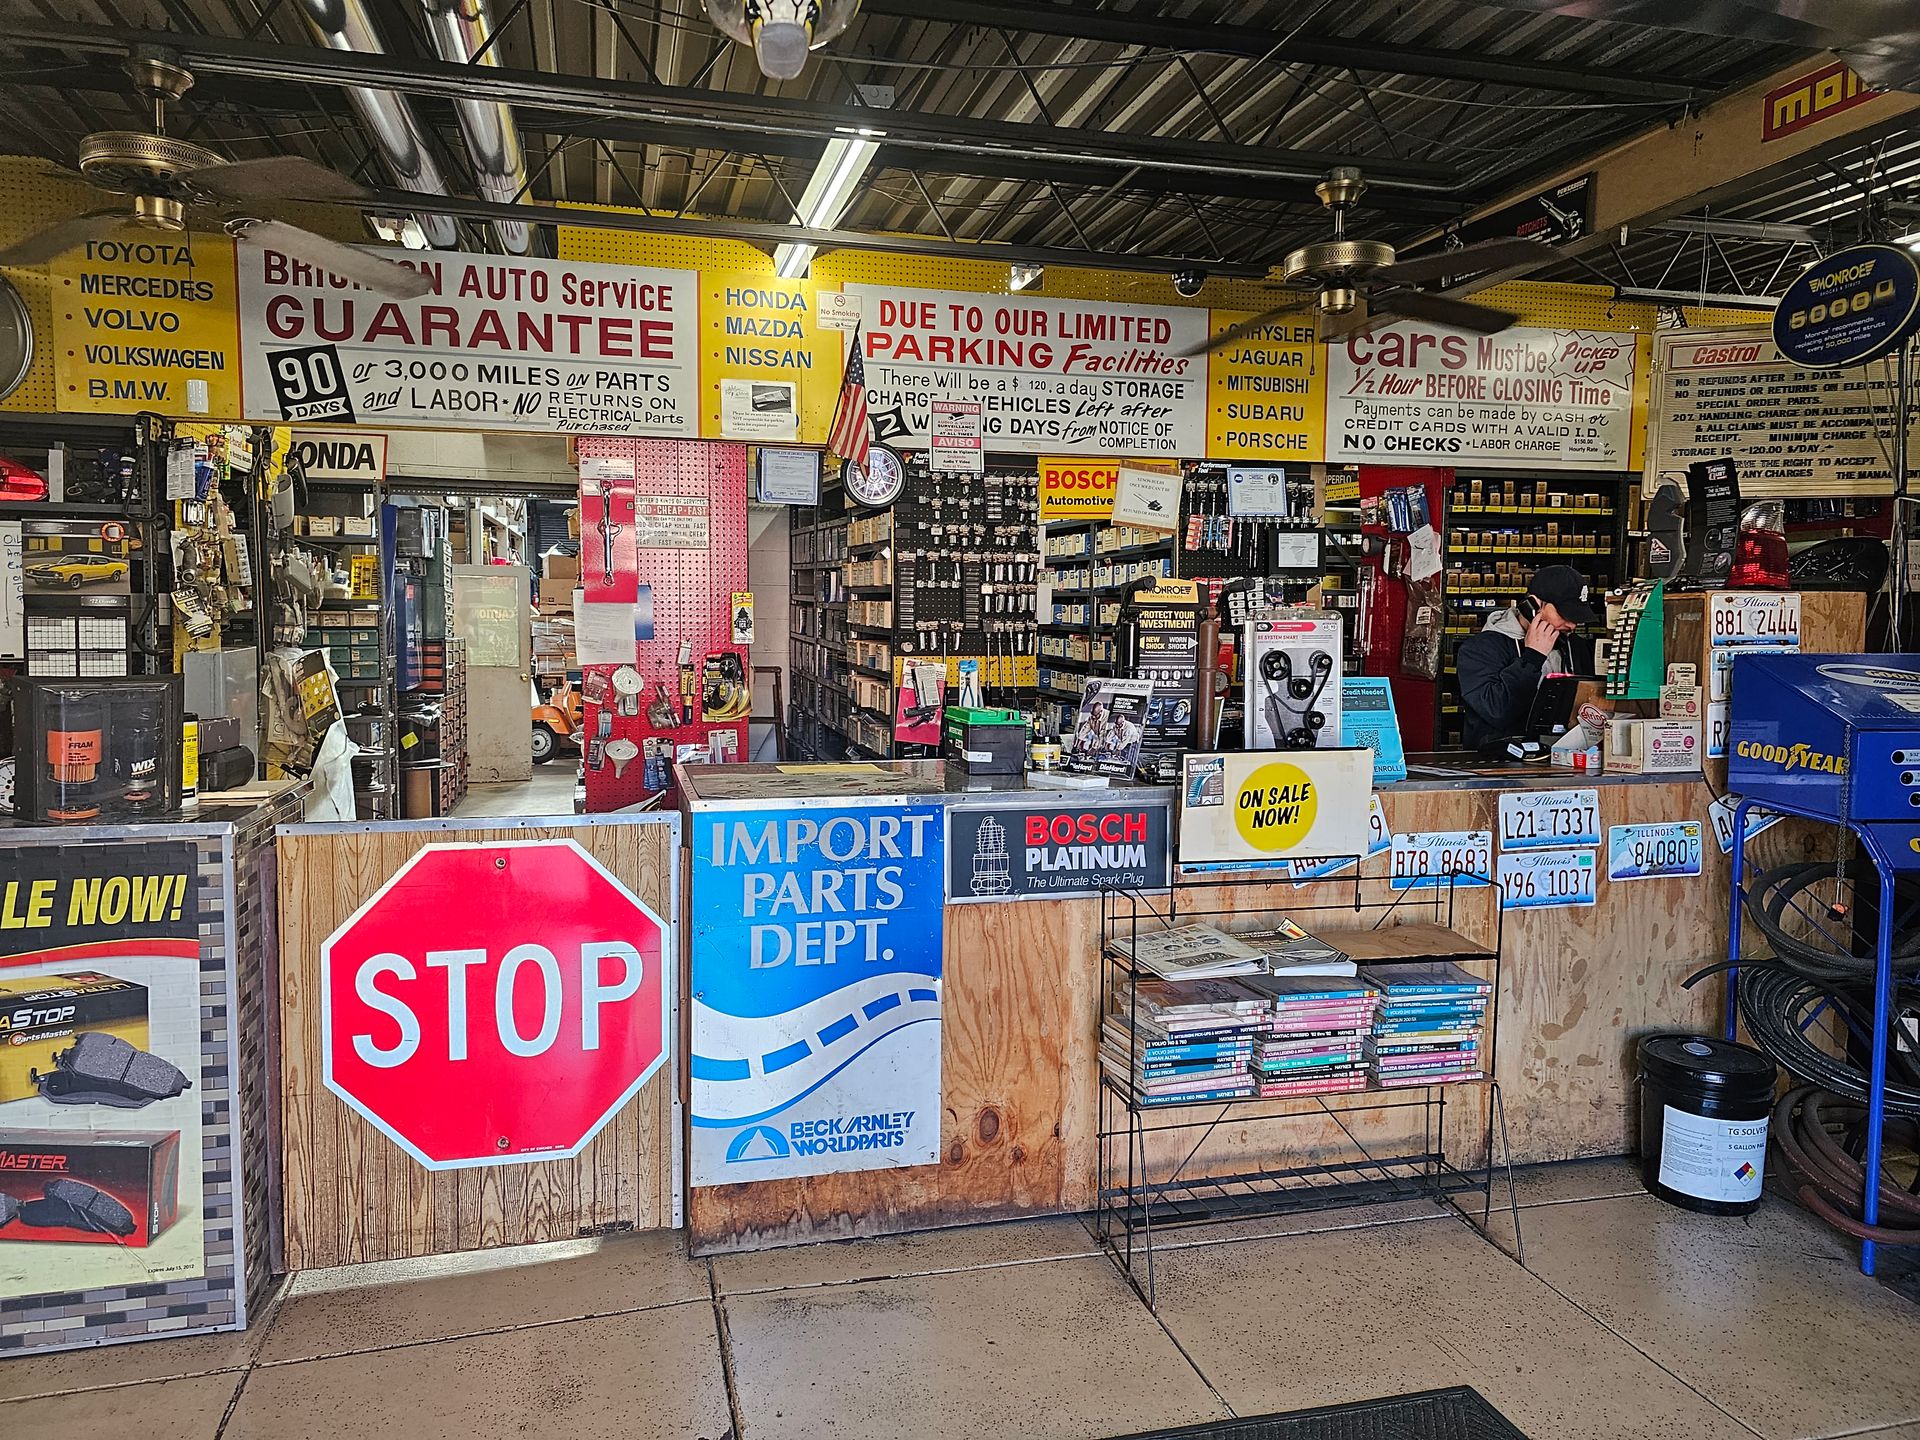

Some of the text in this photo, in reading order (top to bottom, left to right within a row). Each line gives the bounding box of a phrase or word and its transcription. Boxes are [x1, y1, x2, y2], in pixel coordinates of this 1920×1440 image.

[1516, 216, 1548, 237] RATCHETS
[87, 241, 195, 267] TOYOTA
[1809, 259, 1876, 293] MONROE
[81, 274, 214, 301] MERCEDES
[459, 262, 672, 312] AUTO Service
[726, 288, 807, 311] HONDA
[84, 308, 180, 332] VOLVO
[832, 310, 860, 320] Smoking
[880, 300, 1171, 344] DUE TO OUR LIMITED
[1832, 317, 1874, 332] recommends
[265, 295, 674, 359] GUARANTEE
[726, 317, 803, 338] MAZDA
[1824, 321, 1886, 341] shocks struts
[1853, 333, 1871, 342] miles
[85, 345, 224, 370] VOLKSWAGEN
[726, 347, 812, 368] NISSAN
[866, 332, 1189, 375] PARKING Facilities
[1229, 349, 1304, 367] JAGUAR
[1477, 337, 1521, 372] Must
[1525, 347, 1547, 373] be
[1560, 341, 1619, 362] PICKED
[1692, 344, 1762, 365] Castrol
[277, 351, 338, 400] 90
[353, 360, 670, 393] or 3,000 MILES ON PARTS
[1574, 362, 1606, 375] UP
[1698, 370, 1845, 386] REFUNDS AFTER DAYS.
[89, 379, 171, 401] B.M.W.
[880, 368, 1184, 400] There Will be day STORAGE
[1227, 375, 1309, 394] MITSUBISHI
[1378, 373, 1422, 396] Hour
[1425, 373, 1486, 400] BEFORE
[1492, 377, 1563, 404] CLOSING
[1568, 381, 1611, 406] Time
[1698, 384, 1817, 398] REFUNDS RETURNS
[296, 400, 340, 419] DAYS
[362, 387, 676, 415] and LABOR NO RETURNS ON
[933, 403, 979, 413] WARNING
[981, 395, 1173, 418] VEHICLES Left after
[1696, 396, 1823, 410] SPECIAL ORDER PARTS.
[547, 405, 684, 425] ELECTRICAL Parts
[1227, 405, 1304, 421] SUBARU
[1355, 400, 1609, 426] Payments can be made by CASH or
[1699, 408, 1801, 421] HANDLING CHARGE
[556, 419, 630, 433] Purchased
[1010, 411, 1059, 436] DAYS
[1062, 425, 1097, 445] from
[1099, 421, 1153, 436] NOTICE
[1155, 422, 1174, 437] OF
[1344, 419, 1601, 438] CREDIT CARDS WITH VALID I.D.
[1728, 421, 1765, 431] CLAIMS
[938, 438, 975, 447] AVISO
[1099, 437, 1177, 450] COMPLETION
[1226, 432, 1308, 449] PORSCHE
[1344, 435, 1560, 452] NO CHECKS LABOR CHARGE
[1695, 431, 1819, 443] RECEIPT. MINIMUM
[288, 441, 376, 470] ONDA
[1568, 446, 1586, 454] Hourly
[1200, 462, 1232, 470] Performance
[1780, 456, 1877, 467] RIGHT ACCEPT
[1045, 470, 1118, 490] BOSCH
[1764, 468, 1814, 478] CHARGES
[657, 505, 707, 516] CHEAP FAST
[1045, 495, 1114, 507] Automotive
[1139, 610, 1195, 619] PROTECT YOUR
[1716, 609, 1797, 635] 881 2444
[1342, 688, 1384, 696] Credit Needed
[68, 741, 93, 750] FRAM
[131, 757, 157, 772] WIX
[1737, 740, 1847, 775] GOODYEAR
[1099, 764, 1126, 773] DieHard
[1188, 763, 1221, 774] UNICOIL
[1240, 783, 1310, 809] ON SALE
[1252, 807, 1299, 829] NOW!
[1504, 807, 1594, 840] L21 7337
[1025, 812, 1148, 847] BOSCH
[1636, 828, 1675, 838] ILLINOIS
[711, 814, 934, 867] IMPORT
[1025, 845, 1147, 872] PLATINUM
[1441, 849, 1488, 876] 8683
[1634, 840, 1687, 867] 84080
[1026, 873, 1145, 889] The Ultimate Spark Plug
[1503, 869, 1591, 900] Y96 1037
[66, 874, 188, 928] NOW!
[743, 866, 904, 918] PARTS
[750, 918, 895, 969] DEPT.
[351, 941, 645, 1069] STOP
[1727, 1127, 1739, 1136] TG
[790, 1131, 905, 1157] WORLDPARTS
